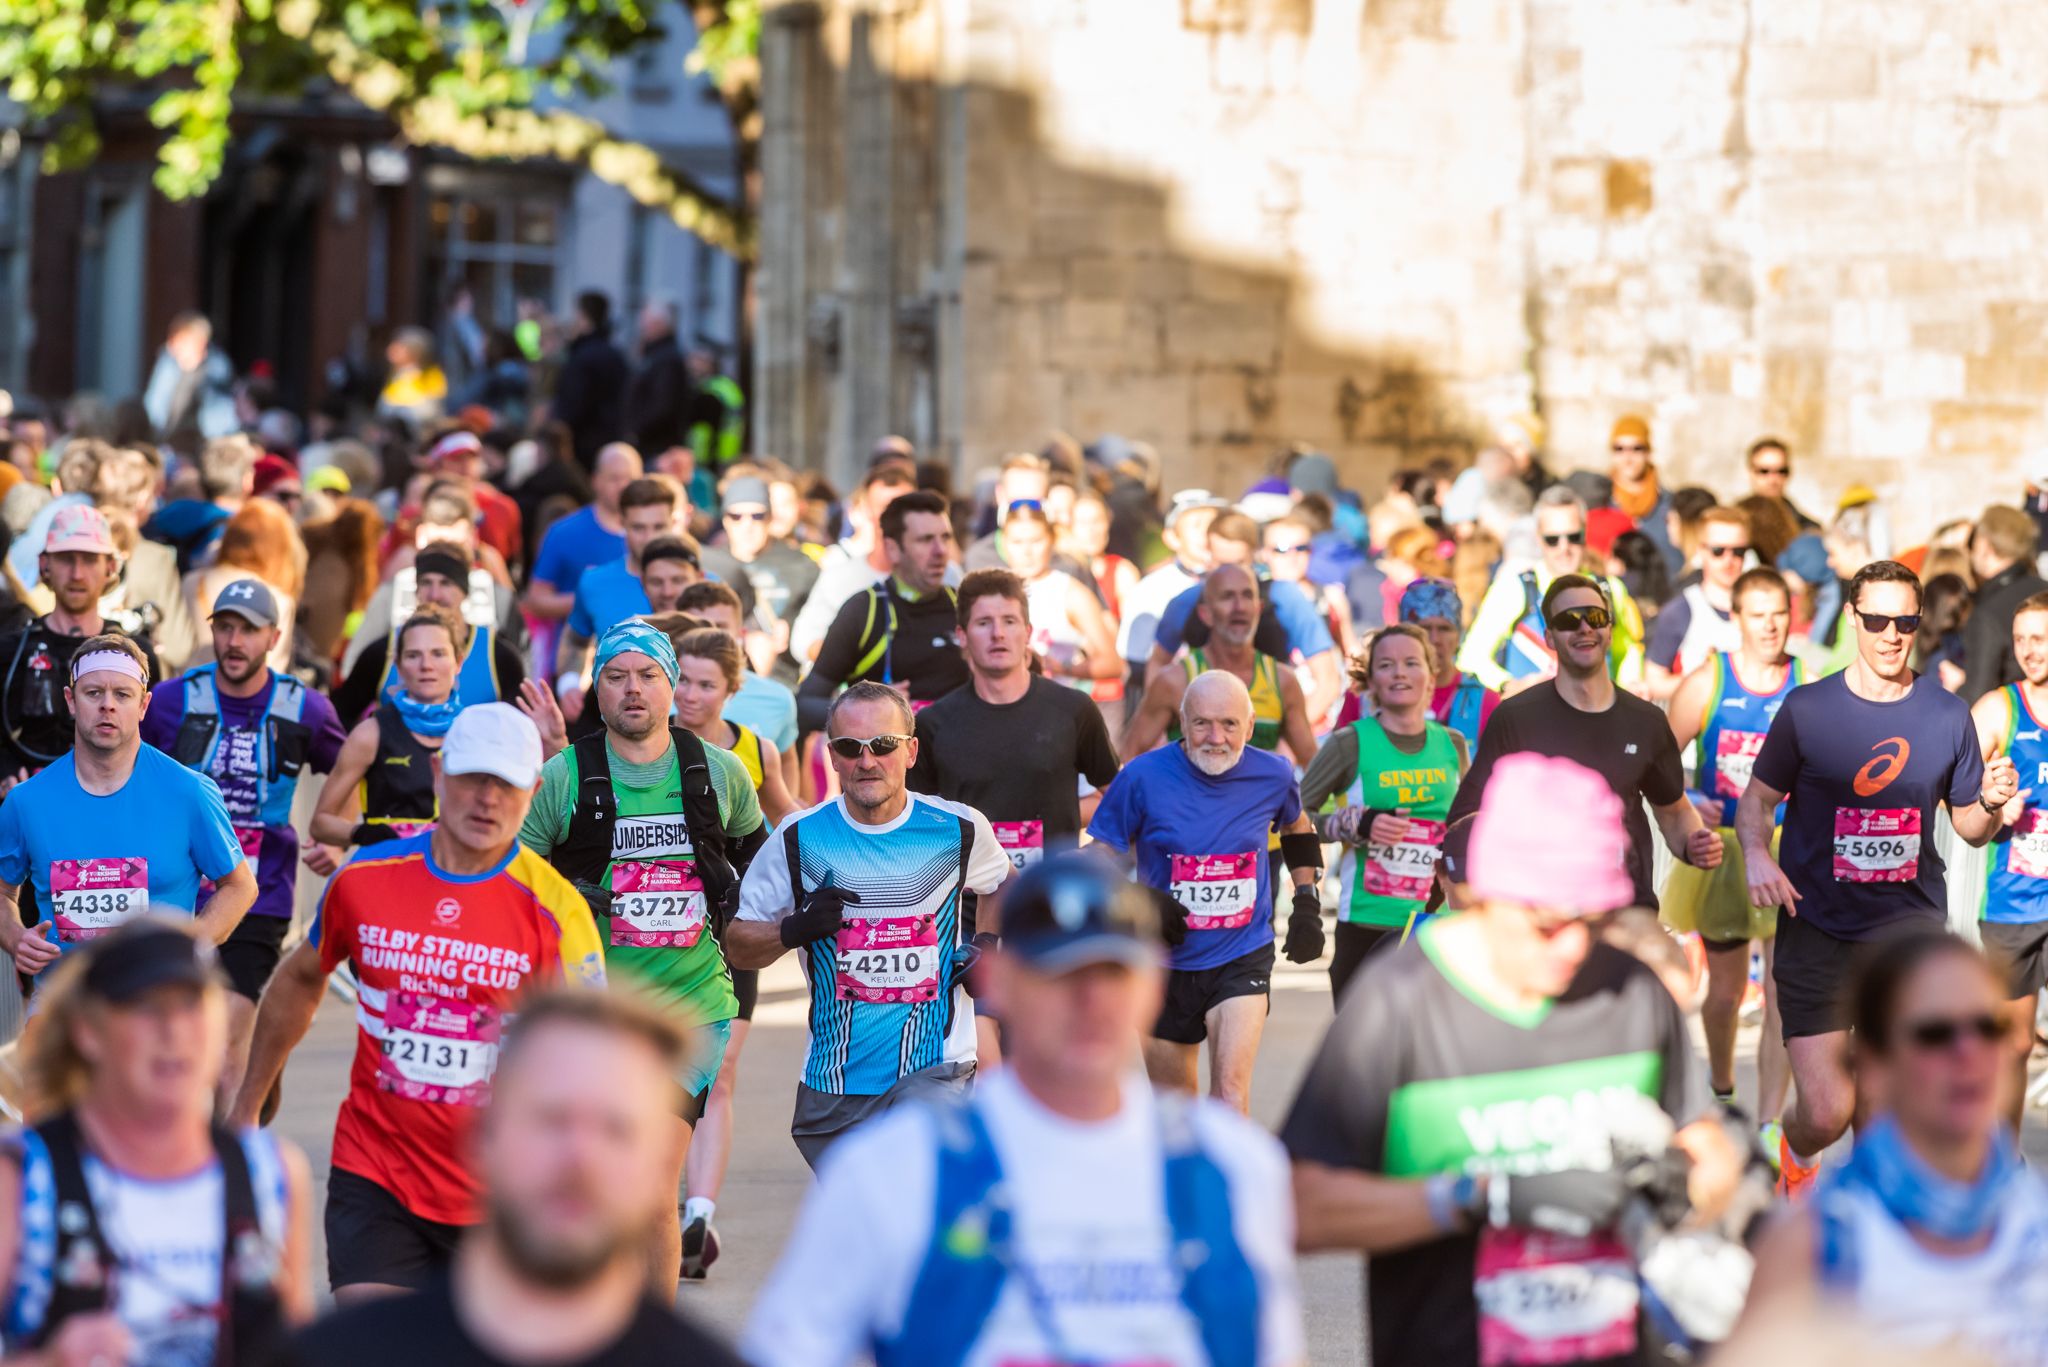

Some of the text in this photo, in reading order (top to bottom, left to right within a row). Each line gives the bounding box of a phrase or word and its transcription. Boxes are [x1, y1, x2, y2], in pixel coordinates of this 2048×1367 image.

[1379, 768, 1447, 787] SINFIN
[1398, 786, 1435, 804] R.C.
[613, 822, 691, 851] UMBERSID
[1383, 844, 1433, 866] 4726
[1851, 840, 1905, 858] 5696
[69, 893, 129, 914] 4338
[1188, 885, 1240, 903] 1374
[630, 897, 690, 917] 3727
[650, 919, 673, 927] CARL
[358, 923, 532, 974] SELBY STRIDERS
[362, 946, 521, 990] RUNNING CLUB
[855, 952, 921, 973] 4210
[400, 974, 469, 999] Richard
[870, 976, 906, 984] KEVLAR
[401, 1038, 468, 1069] 2131
